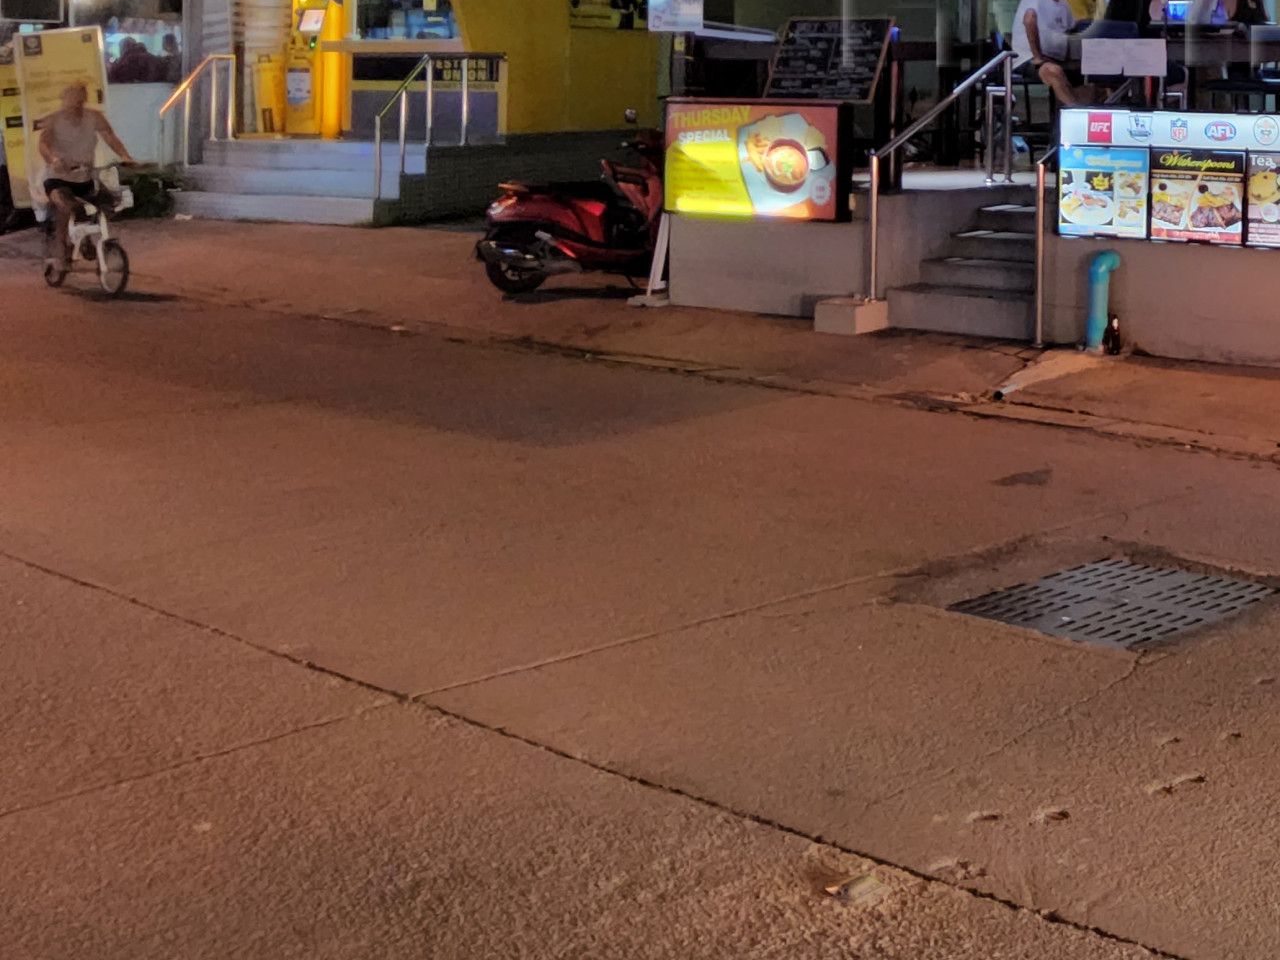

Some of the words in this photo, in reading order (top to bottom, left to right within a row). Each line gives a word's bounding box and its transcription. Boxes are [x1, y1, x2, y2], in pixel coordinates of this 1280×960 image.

[443, 69, 488, 81] UNON
[671, 106, 751, 128] THURSDAY
[1090, 121, 1111, 133] UFC
[1207, 124, 1236, 138] AFL
[677, 129, 730, 145] SPECIAL
[1160, 151, 1236, 172] Witherspoons
[1250, 154, 1273, 167] Tea
